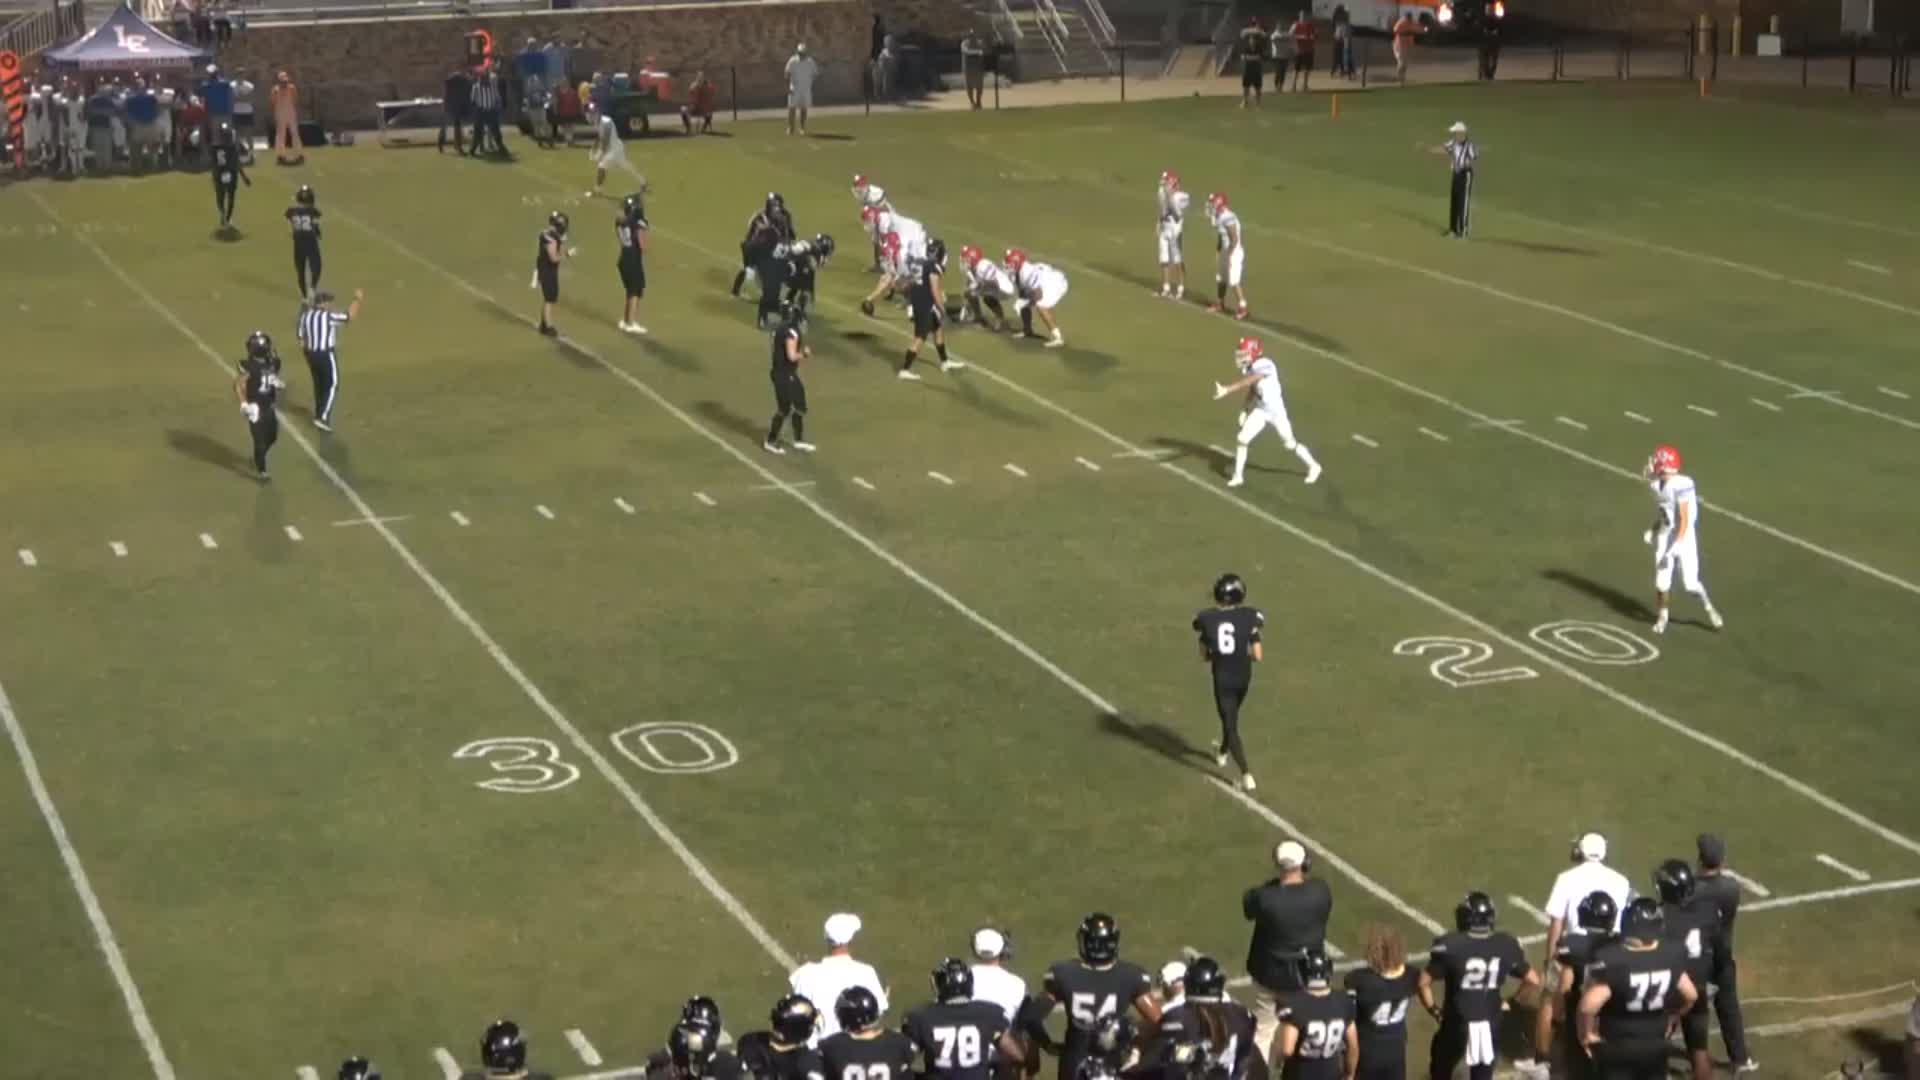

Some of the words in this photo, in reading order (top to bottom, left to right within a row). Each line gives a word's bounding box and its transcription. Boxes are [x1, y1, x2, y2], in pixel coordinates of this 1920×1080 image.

[1217, 621, 1236, 655] 6
[1393, 619, 1660, 687] 20
[453, 721, 739, 792] 30
[1461, 957, 1501, 989] 21
[1627, 969, 1672, 1012] 77
[1071, 991, 1118, 1030] 54
[932, 1025, 982, 1068] 78
[1300, 1019, 1345, 1058] 28
